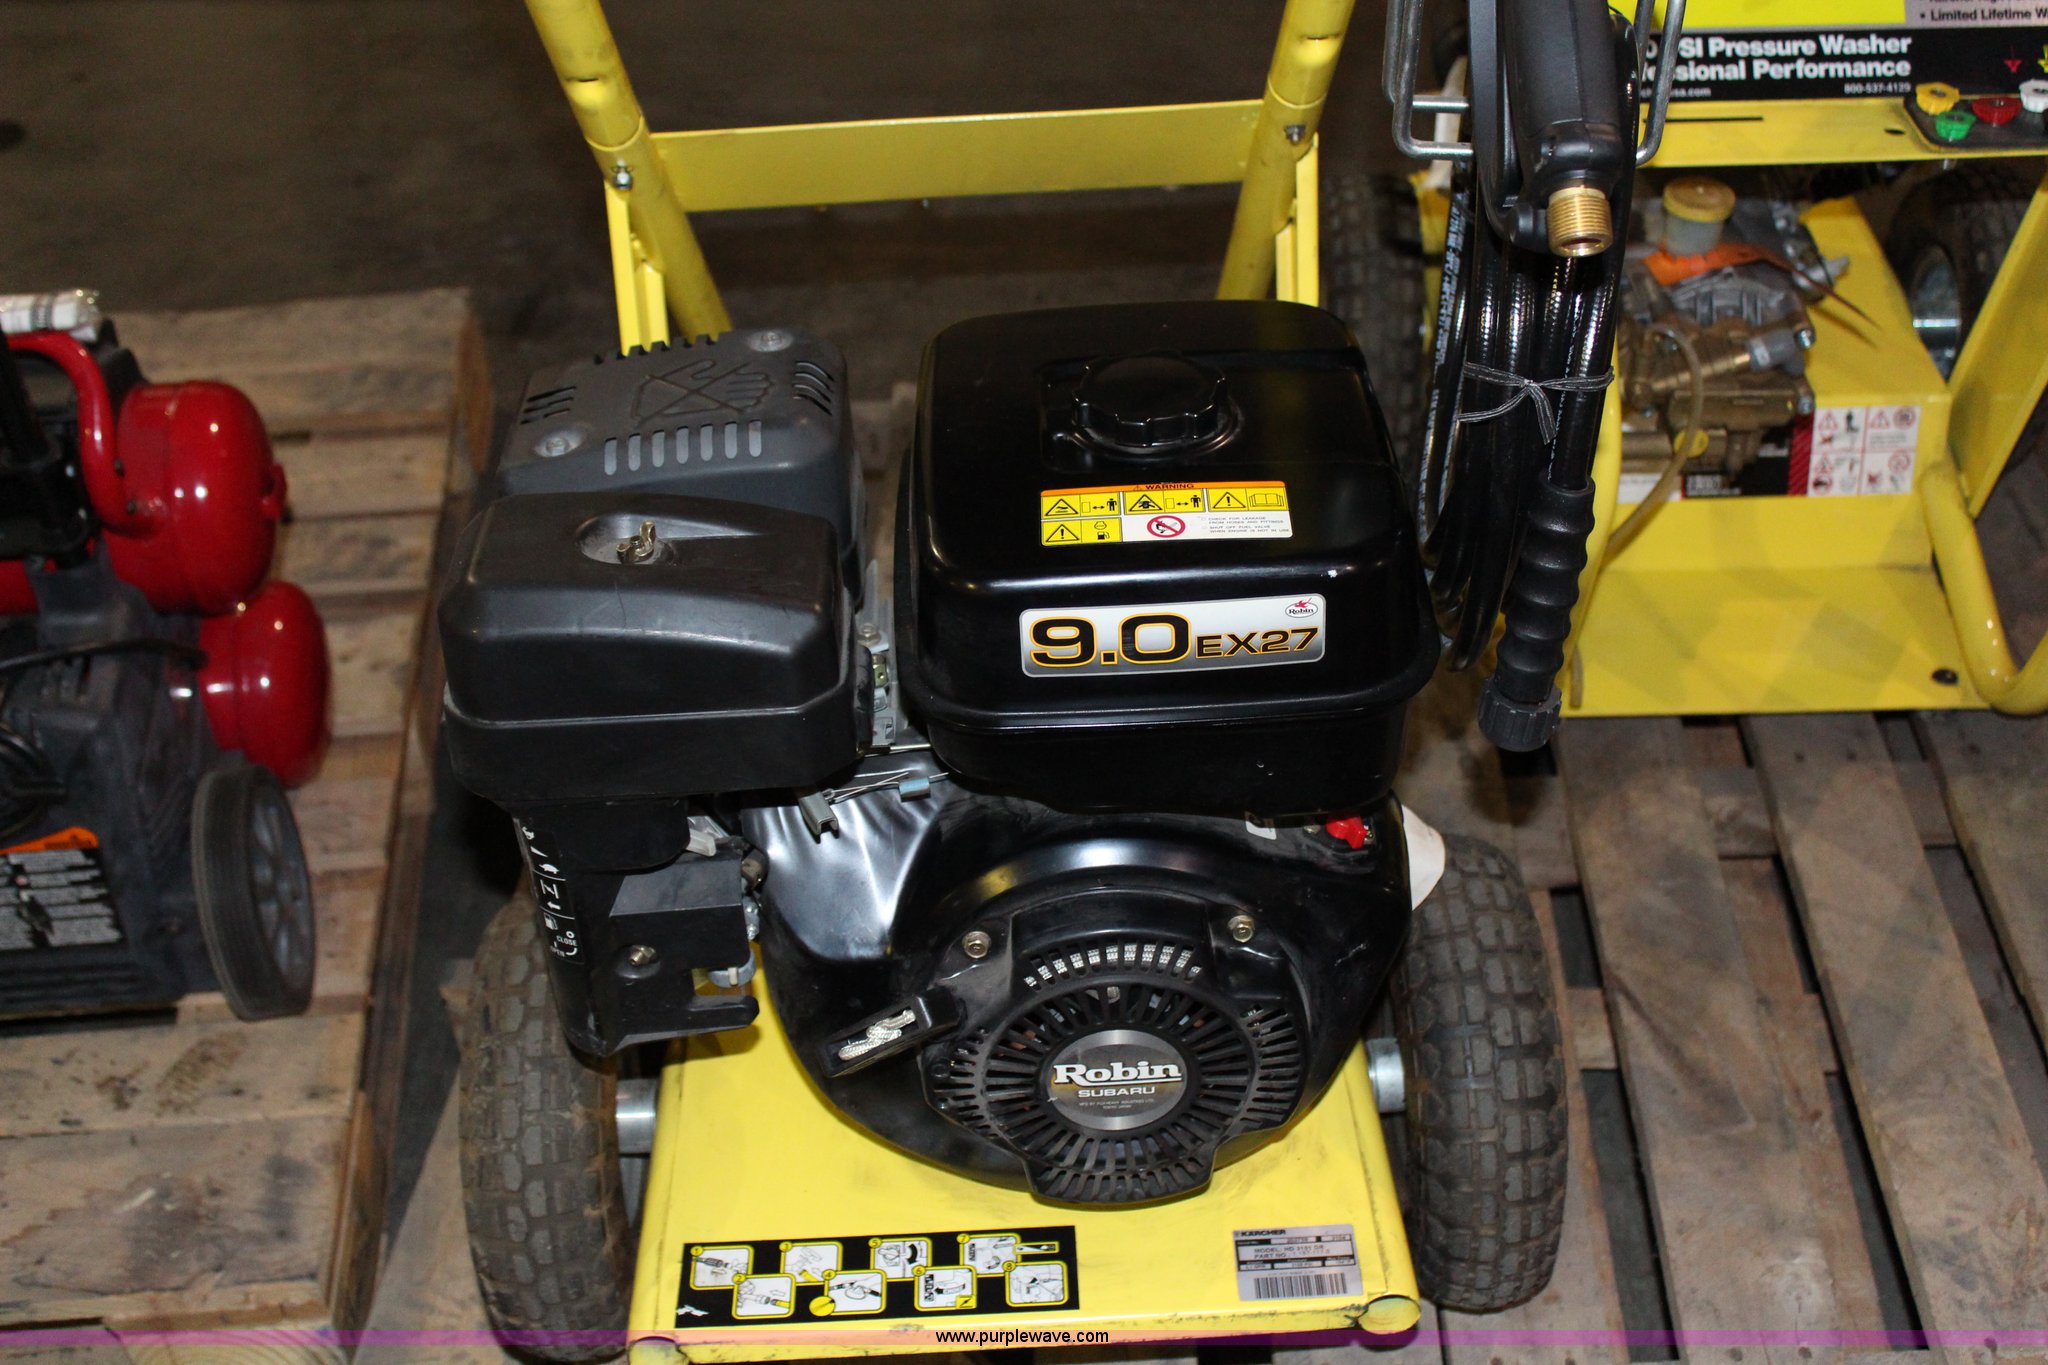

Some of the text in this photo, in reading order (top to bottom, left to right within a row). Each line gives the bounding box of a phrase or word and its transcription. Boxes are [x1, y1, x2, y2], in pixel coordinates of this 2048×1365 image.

[1931, 7, 2048, 21] Limited Lifetime W
[1708, 35, 1817, 58] Pressure
[1819, 33, 1912, 56] Washer
[1752, 58, 1911, 80] Performance
[1145, 482, 1194, 490] WARNING
[1288, 607, 1314, 615] Robin
[1030, 612, 1319, 667] 9.0 EX27
[556, 935, 578, 947] CLOSE
[1053, 1061, 1182, 1087] Robin
[1078, 1086, 1155, 1098] SUBARU
